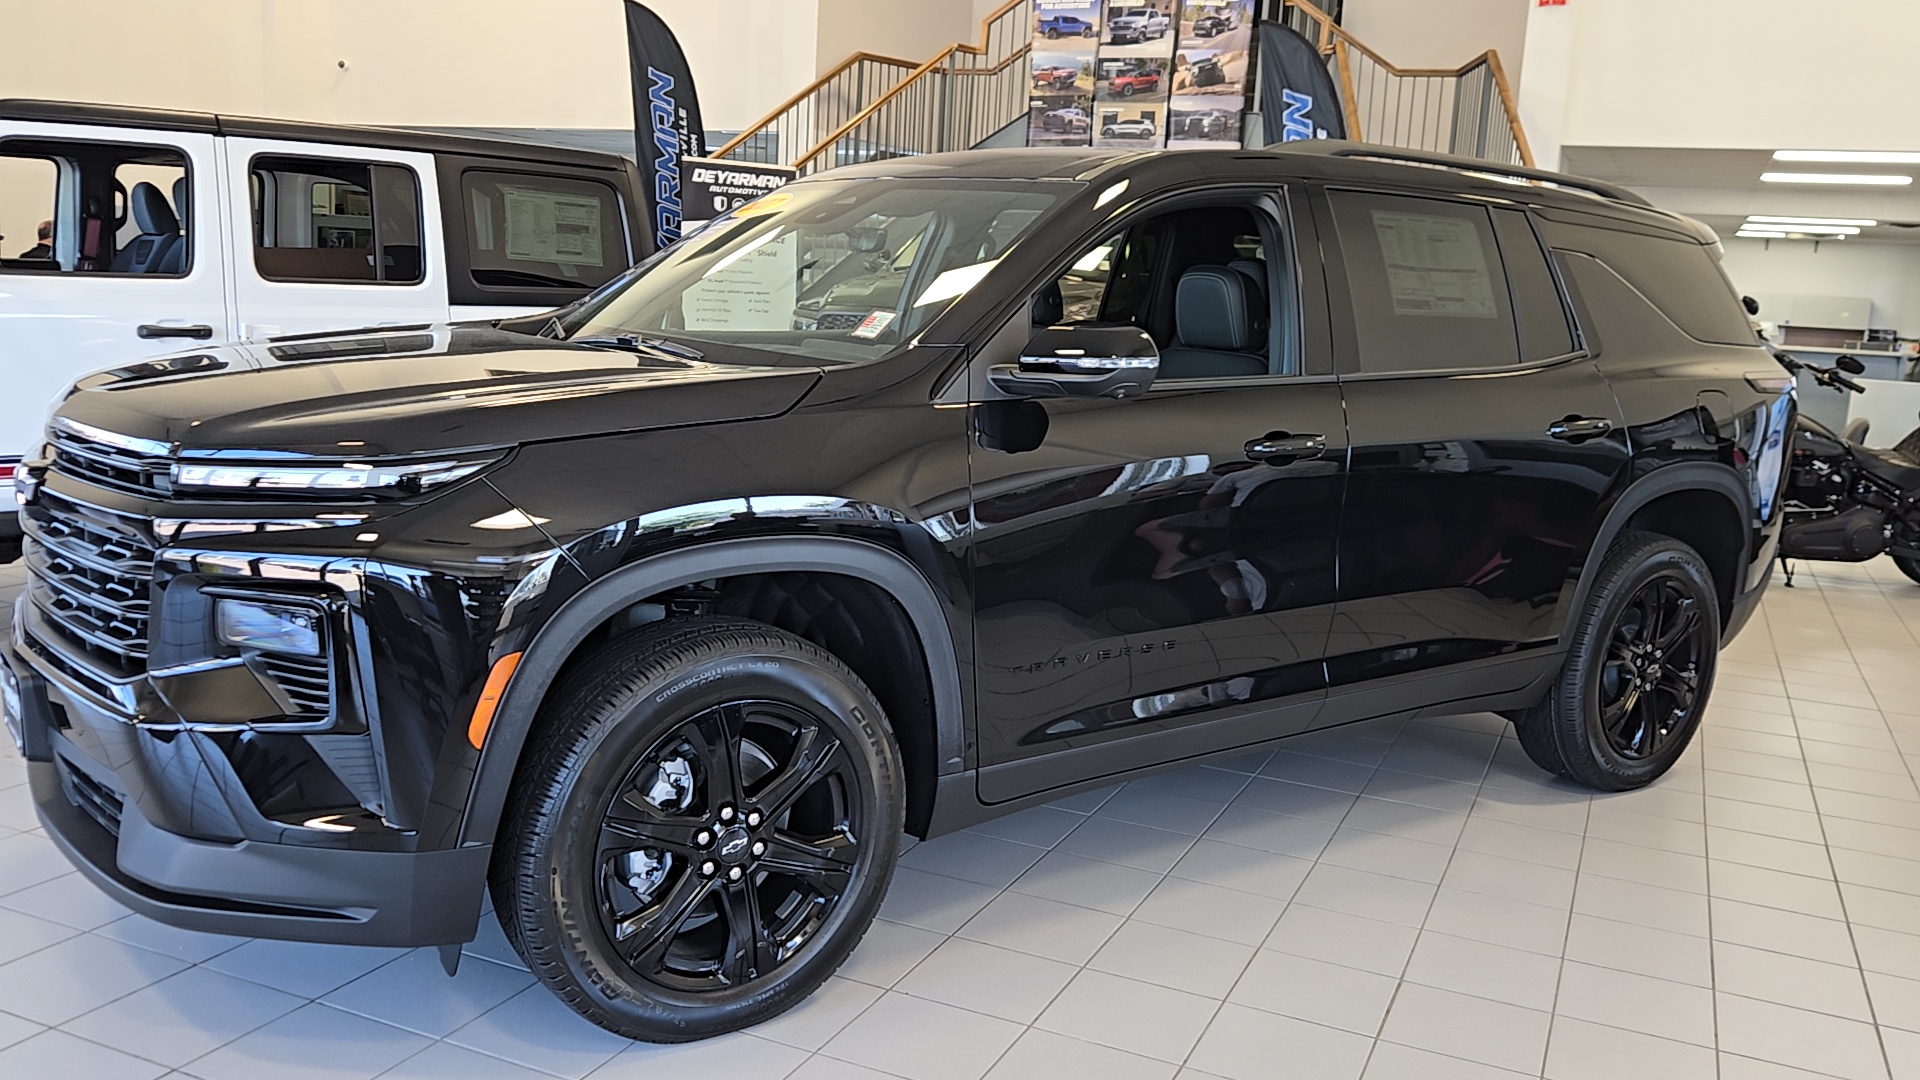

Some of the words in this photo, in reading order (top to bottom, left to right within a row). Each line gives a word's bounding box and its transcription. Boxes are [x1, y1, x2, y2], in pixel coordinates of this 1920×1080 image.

[691, 167, 787, 189] DEYARMAN
[1008, 639, 1176, 674] TRAVERSE
[655, 663, 743, 703] CROSSCONTACT
